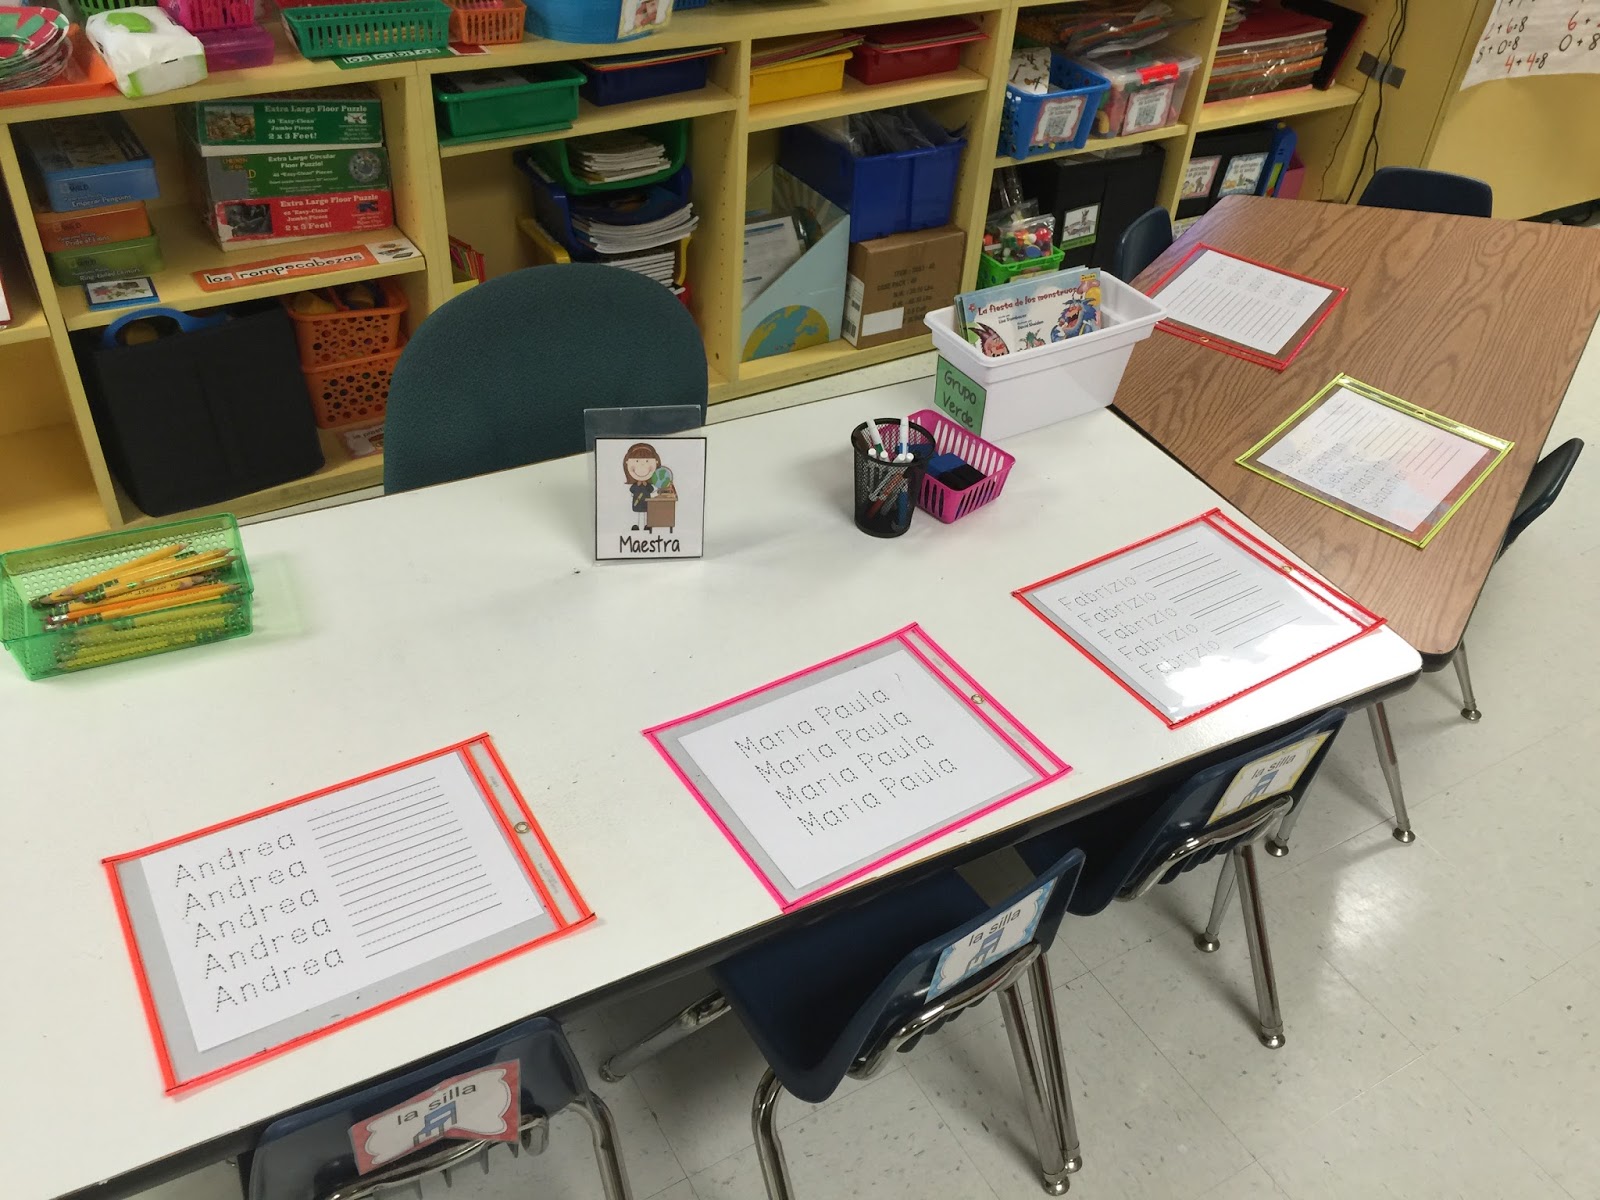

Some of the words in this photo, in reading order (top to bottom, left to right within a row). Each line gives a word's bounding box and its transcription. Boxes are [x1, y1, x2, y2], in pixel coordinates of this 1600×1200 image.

[291, 105, 315, 113] Large
[280, 200, 304, 208] Extra
[308, 222, 332, 230] Feet!
[206, 274, 232, 284] los
[240, 254, 363, 279] rompecabezas
[978, 307, 988, 316] La
[988, 302, 1013, 313] fiesta
[1014, 298, 1024, 306] de
[1024, 296, 1036, 305] los
[1038, 287, 1077, 300] monstruos
[944, 370, 976, 405] Grupo
[943, 391, 973, 428] Verde
[620, 535, 680, 553] Maestra
[1058, 576, 1136, 612] Fabrizio
[1077, 592, 1156, 628] Fabrizio
[1097, 608, 1177, 644] Fabrizio
[1118, 624, 1198, 662] Fabrizio
[1138, 640, 1220, 679] Fabrizio
[734, 720, 816, 760] Maria
[814, 690, 890, 726] Paula
[754, 743, 837, 784] Maria
[836, 712, 912, 748] Paula
[1251, 768, 1264, 780] la
[1268, 754, 1296, 772] silla
[776, 768, 858, 810] Maria
[857, 735, 934, 773] Paula
[796, 792, 882, 836] Maria
[879, 758, 958, 798] Paula
[176, 834, 296, 888] Andrea
[185, 861, 307, 918] Andrea
[195, 889, 319, 948] Andrea
[968, 932, 984, 946] la
[989, 908, 1021, 934] silla
[206, 918, 332, 980] Andrea
[216, 948, 344, 1012] Andrea
[398, 1110, 418, 1126] la
[428, 1084, 476, 1110] silla
